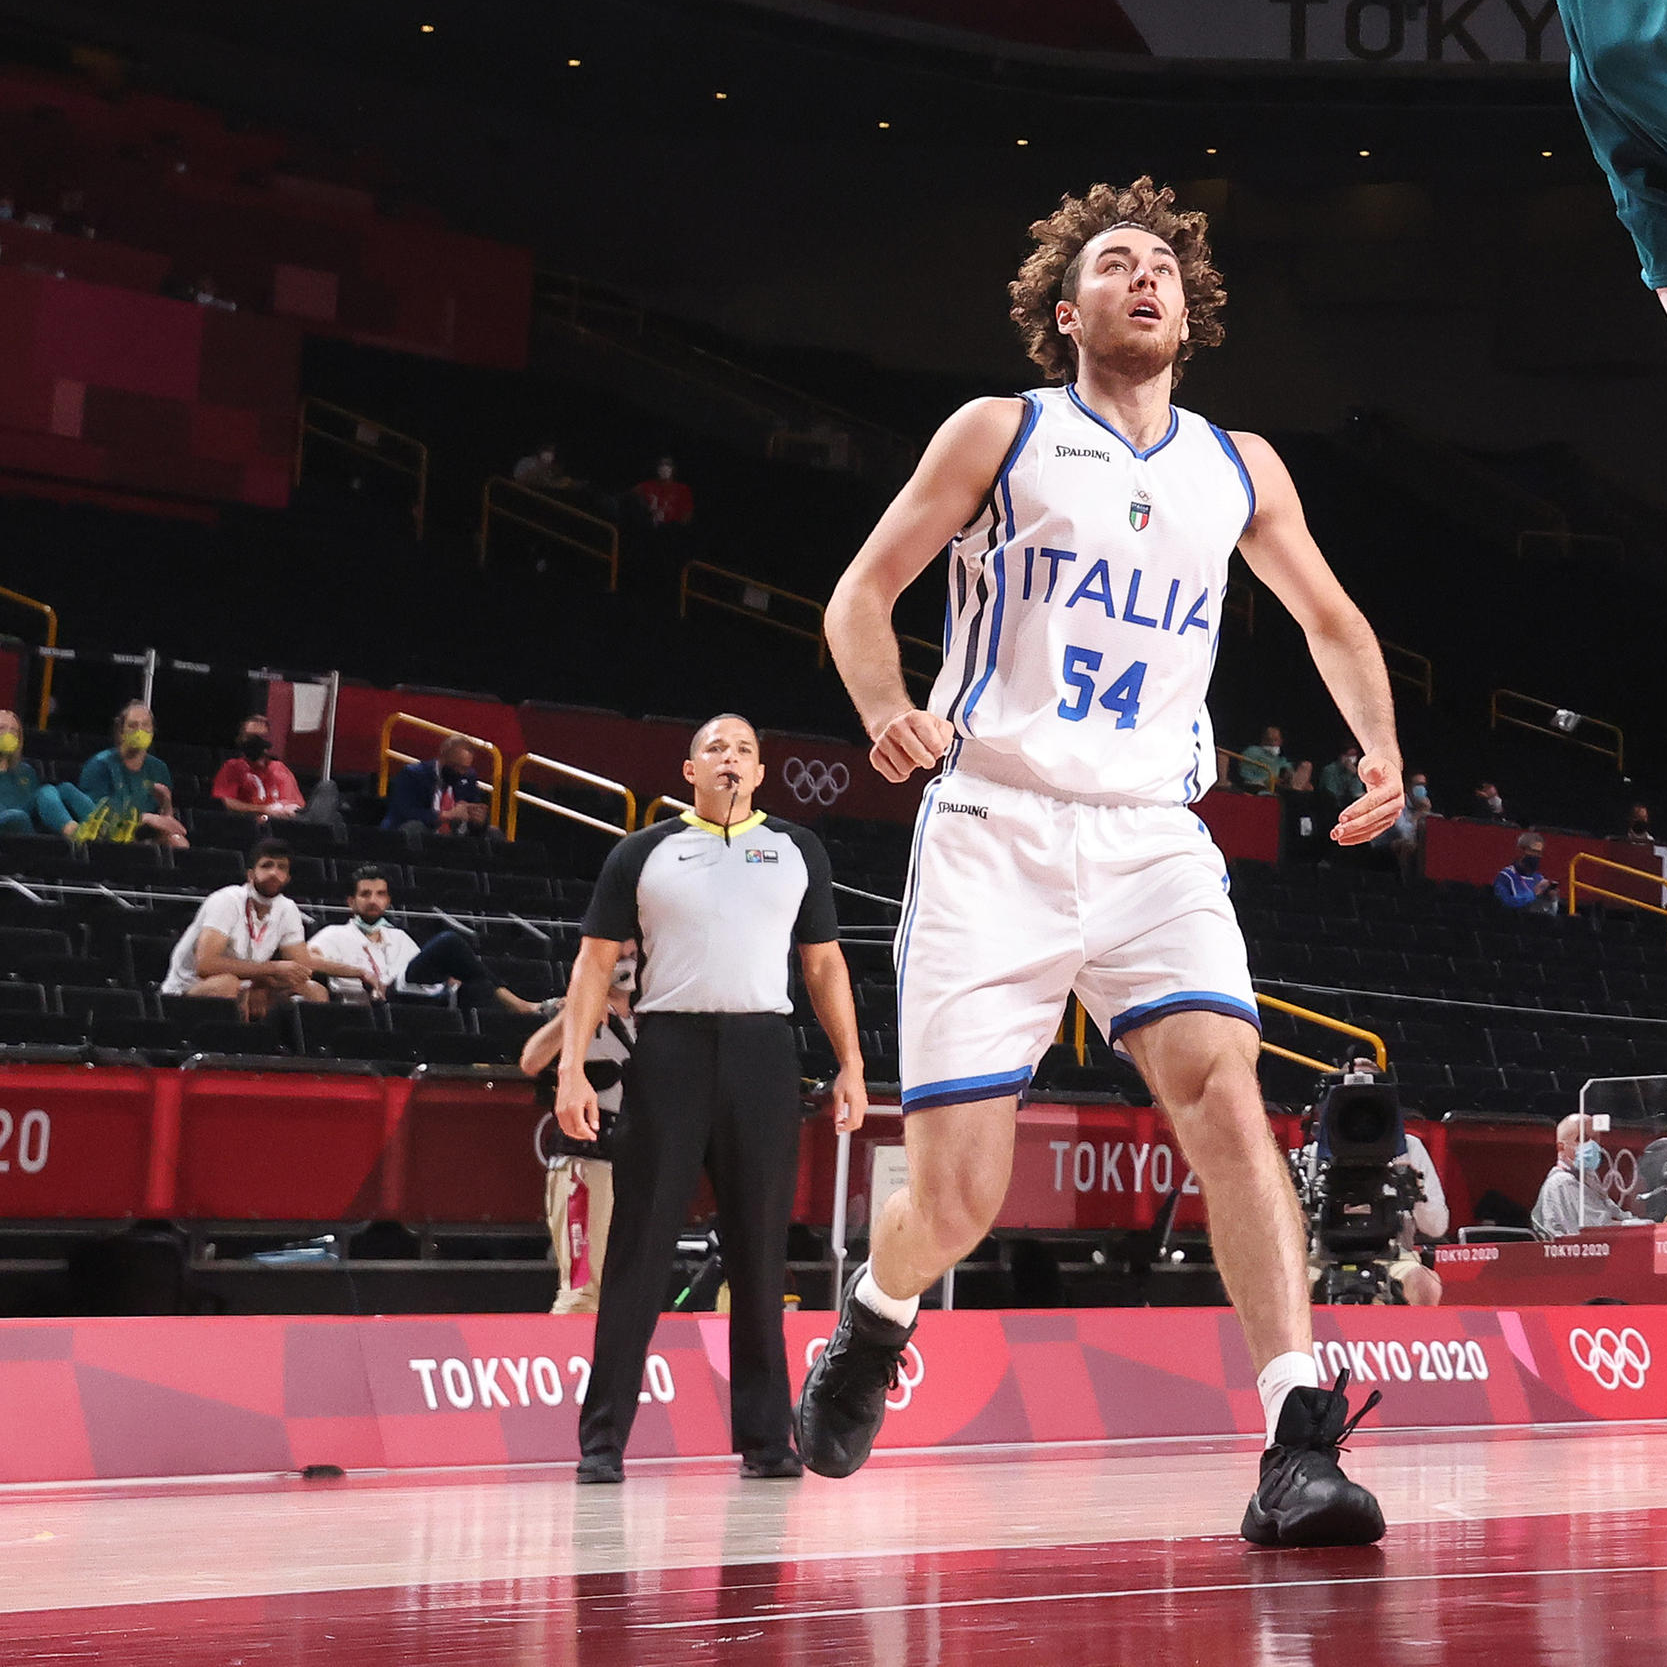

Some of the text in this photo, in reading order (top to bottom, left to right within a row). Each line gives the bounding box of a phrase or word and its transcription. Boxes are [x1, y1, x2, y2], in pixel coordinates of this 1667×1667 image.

[1054, 444, 1111, 463] SPALDING
[1022, 546, 1211, 640] ITALIA
[1057, 644, 1148, 730] 54
[936, 799, 990, 821] SPALDING
[1049, 1140, 1174, 1194] TOKYO
[1471, 1247, 1499, 1261] 2020
[1544, 1243, 1610, 1258] TOKYO 2020
[408, 1354, 676, 1411] TOKYO 20
[1312, 1340, 1490, 1383] TOKYO 2020
